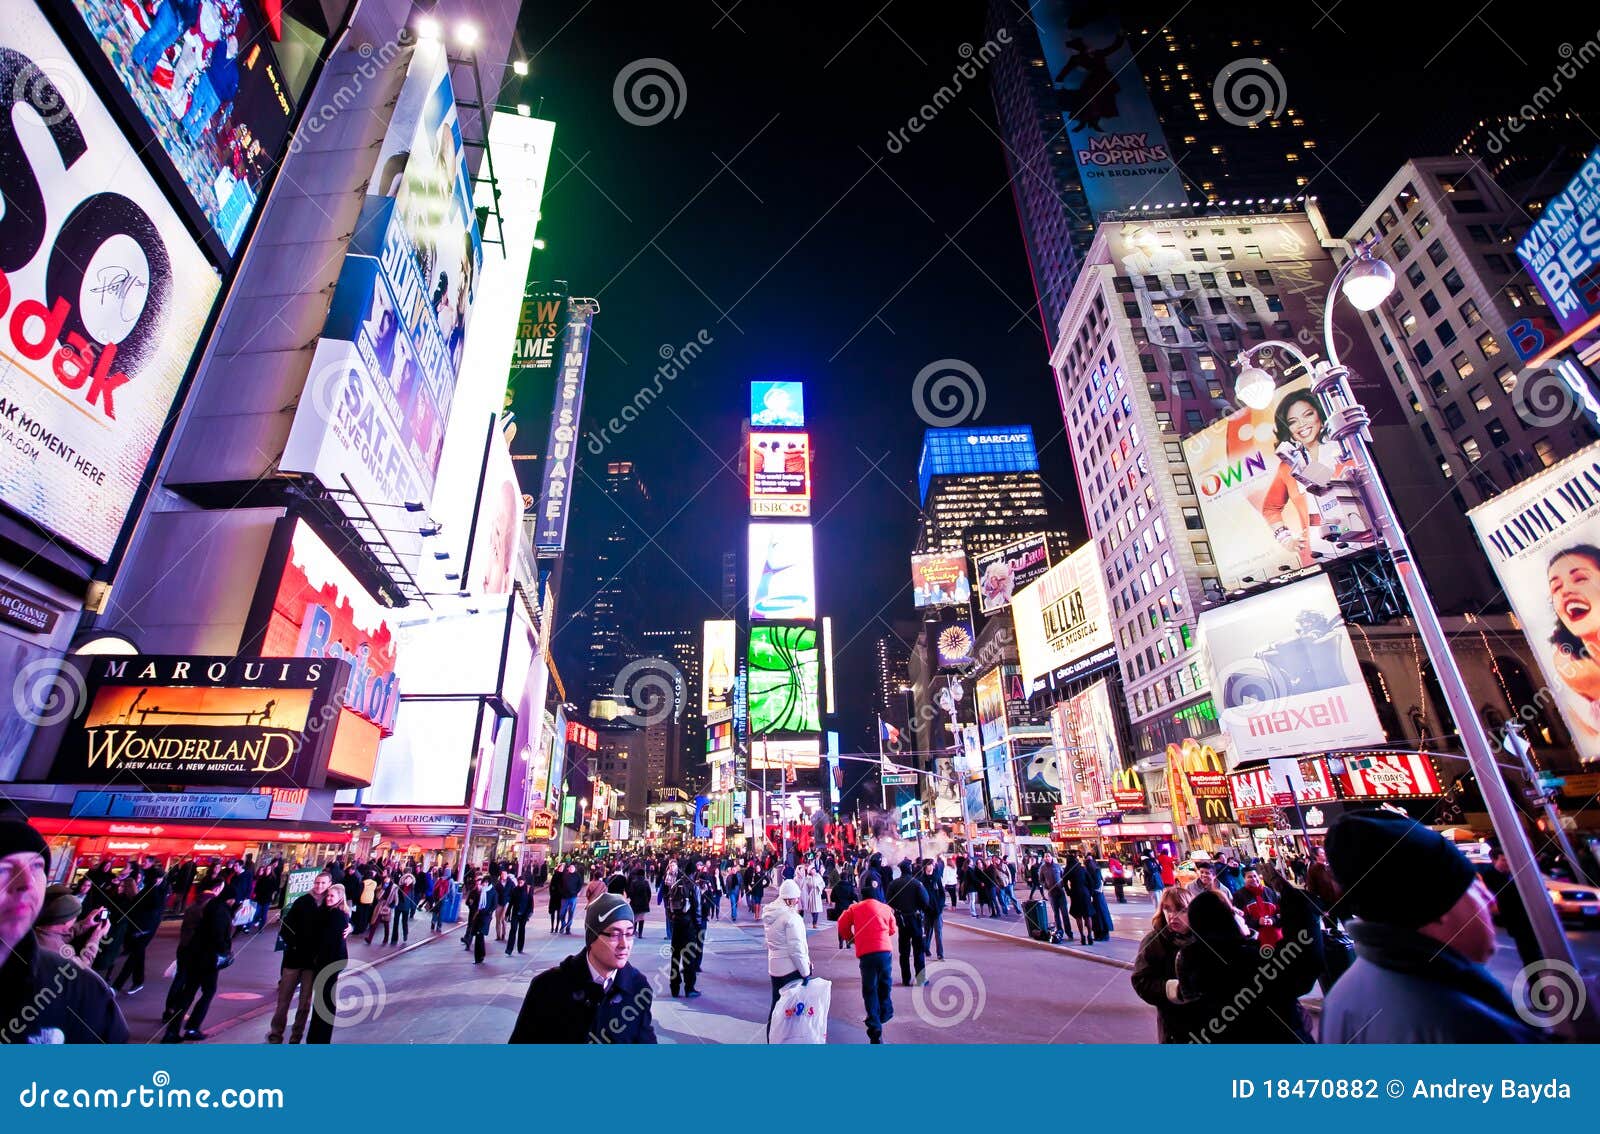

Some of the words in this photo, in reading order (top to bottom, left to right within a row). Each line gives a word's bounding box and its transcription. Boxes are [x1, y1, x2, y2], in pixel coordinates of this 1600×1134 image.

[1088, 133, 1148, 151] MARY
[1078, 144, 1168, 167] POPPINS
[1086, 171, 1104, 179] ON
[1107, 166, 1171, 178] BROADWAY
[1182, 218, 1240, 228] Colombian
[1532, 241, 1556, 274] 2010
[1552, 213, 1580, 248] TONY
[562, 322, 586, 400] TIMES
[18, 413, 76, 462] MOMENT
[74, 456, 106, 488] HERE
[980, 434, 1028, 443] BARCLAYS
[546, 408, 574, 518] SQUARE
[1201, 451, 1266, 496] OWN
[754, 503, 788, 512] HSBC
[1488, 497, 1567, 562] MAMMA
[1051, 637, 1064, 652] THE
[1065, 622, 1098, 646] MUSICAL
[104, 661, 322, 682] MARQUIS
[1247, 695, 1349, 737] maxell
[87, 730, 295, 772] WONDERLAND
[1064, 709, 1084, 782] PALACE
[125, 762, 145, 770] NEW
[147, 762, 173, 770] ALICE.
[185, 763, 205, 771] NEW
[207, 763, 247, 772] MUSICAL.
[200, 795, 218, 804] place
[392, 815, 441, 823] AMERICAN
